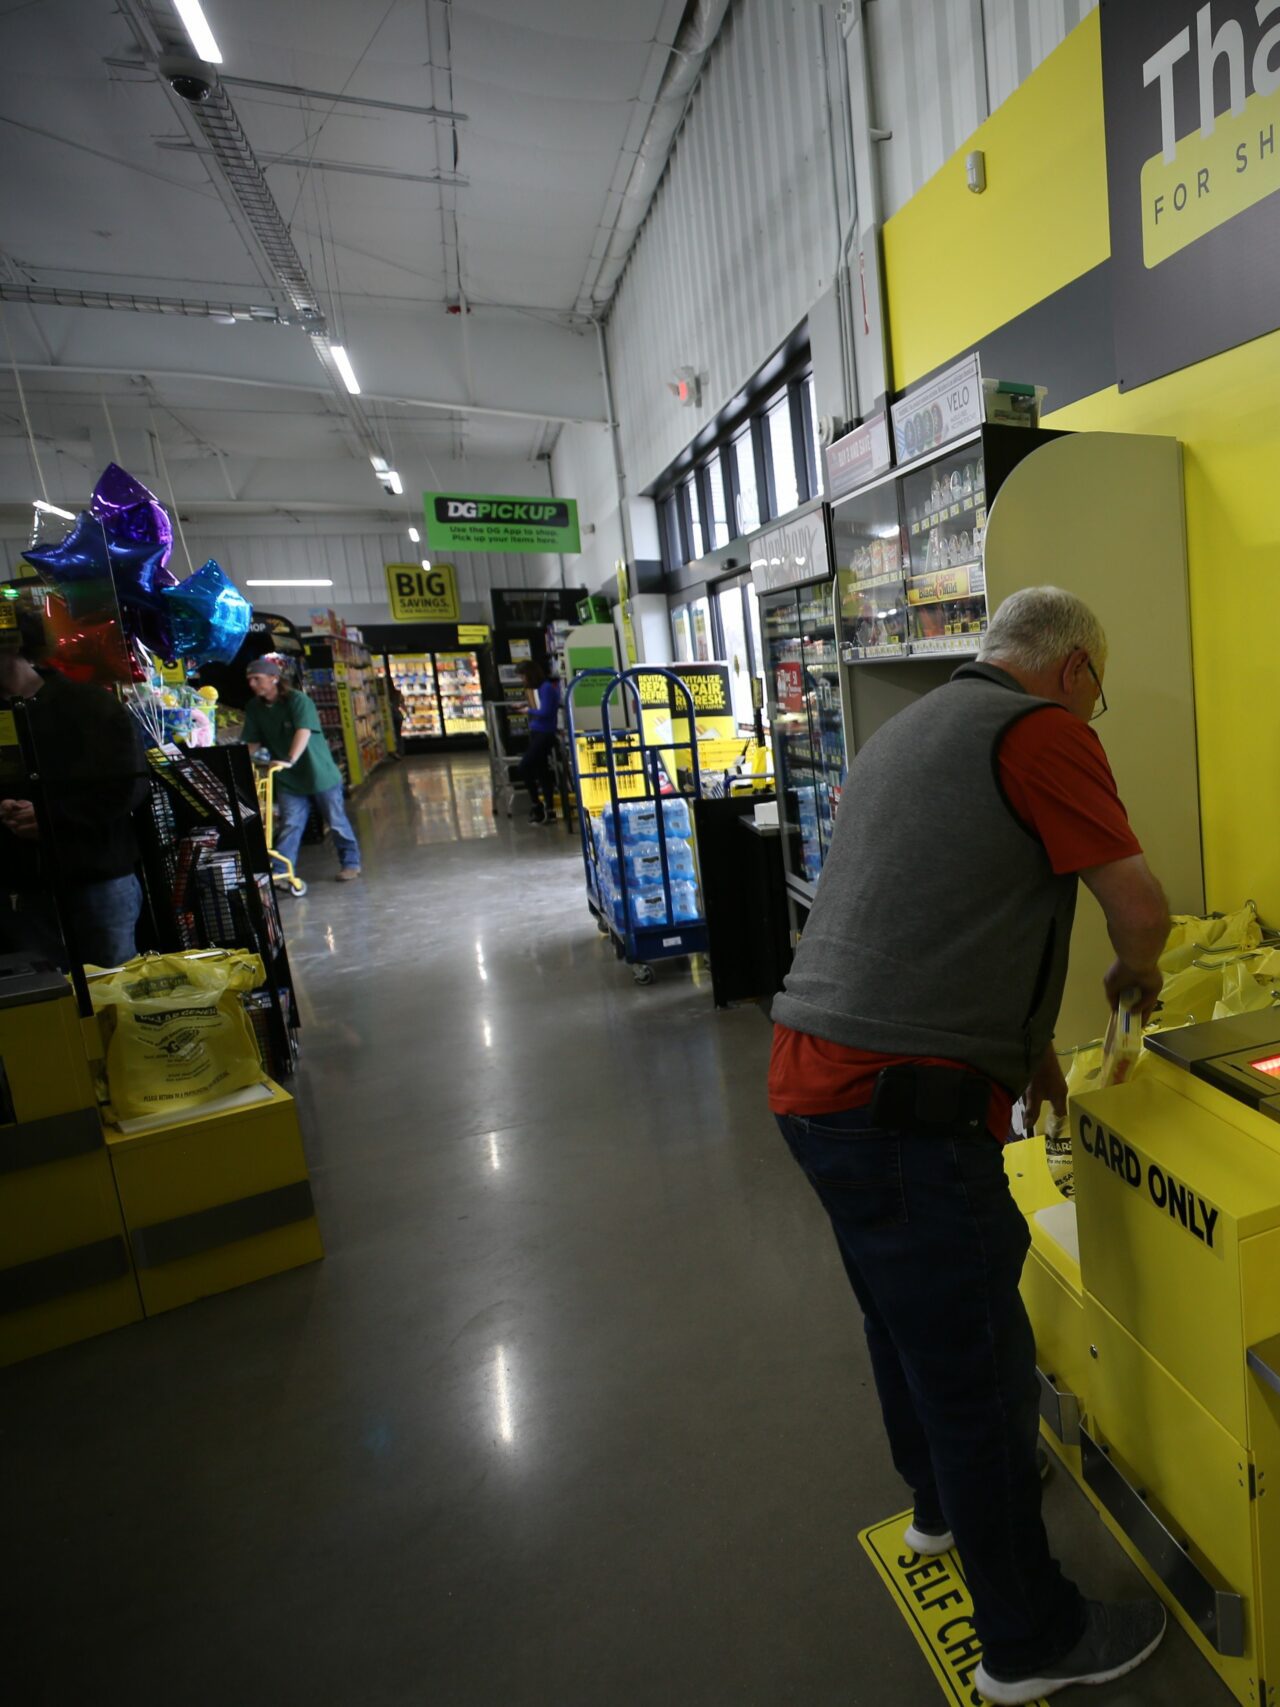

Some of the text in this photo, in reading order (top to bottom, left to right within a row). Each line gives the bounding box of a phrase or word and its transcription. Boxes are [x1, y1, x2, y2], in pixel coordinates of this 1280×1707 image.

[1154, 167, 1211, 226] FOR
[946, 385, 970, 413] VELO
[395, 573, 446, 597] BIG
[400, 598, 449, 608] SAVINGS.
[640, 682, 668, 692] REPA
[641, 690, 668, 701] REFRE
[674, 683, 724, 696] RPAIR.
[1079, 1114, 1218, 1248] CARD ONLY
[897, 1551, 964, 1611] SELF
